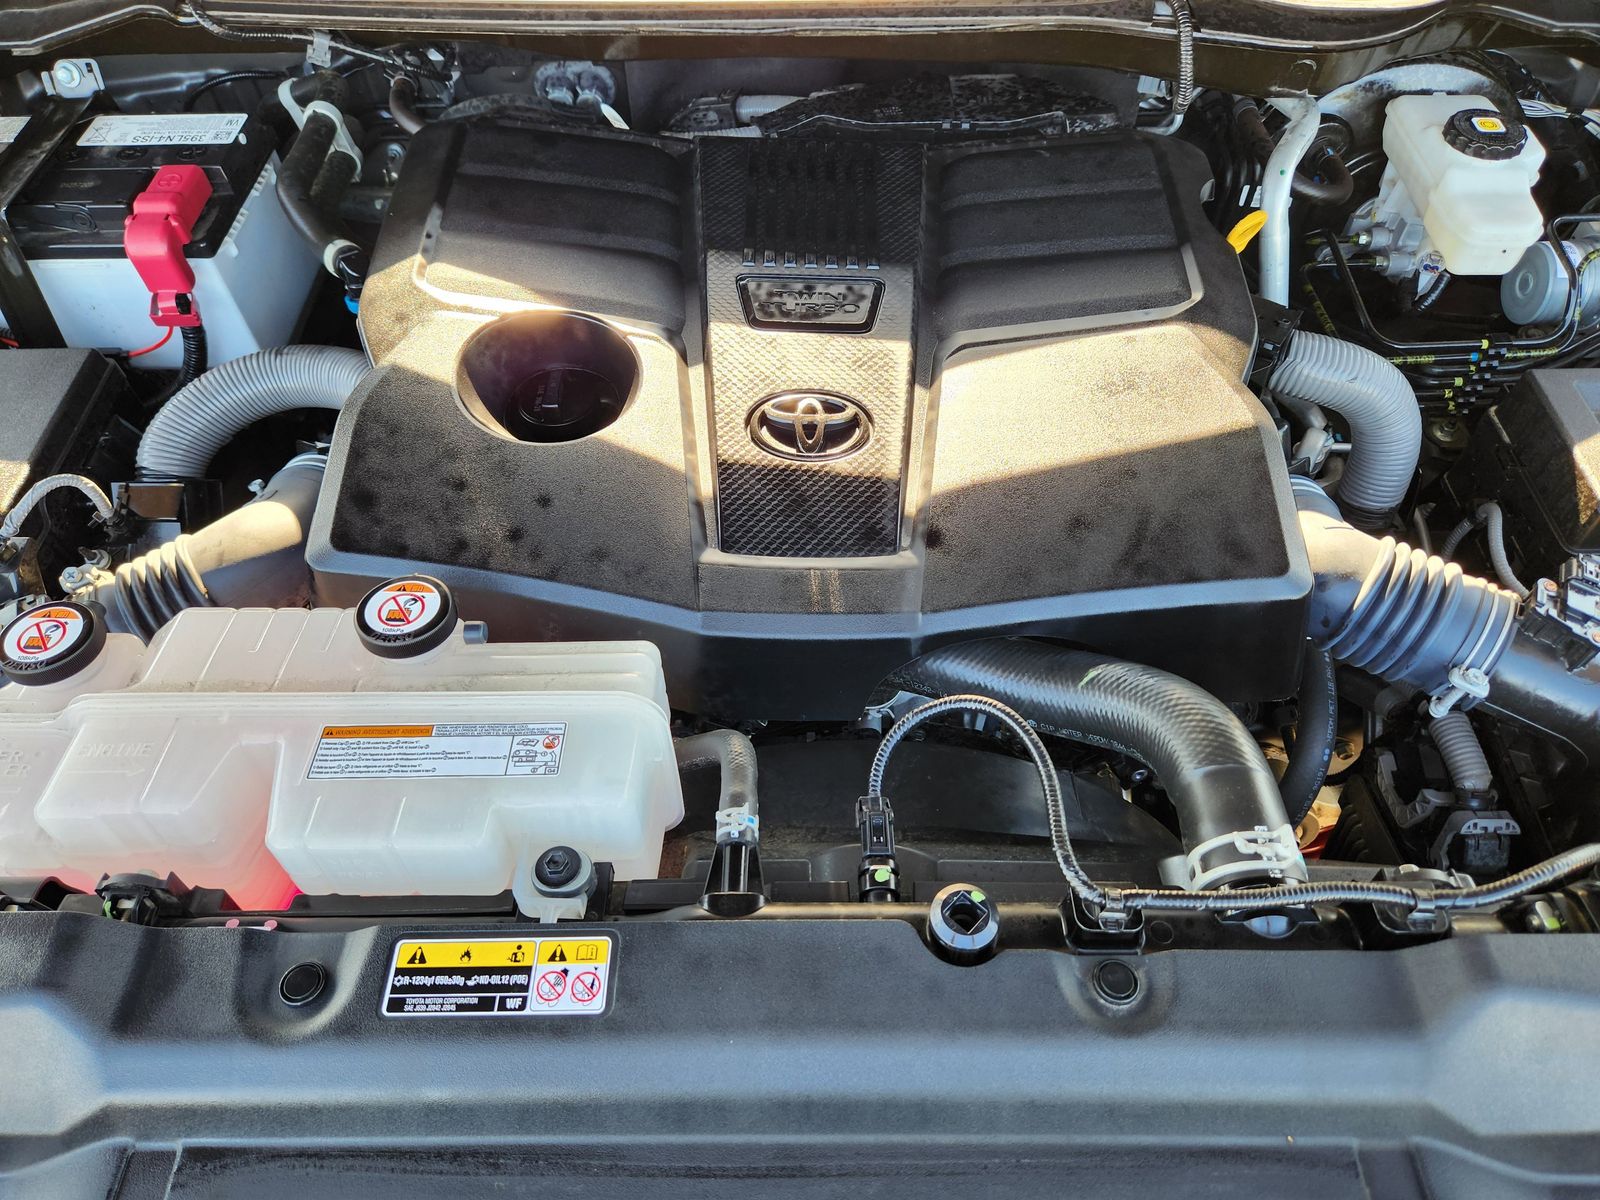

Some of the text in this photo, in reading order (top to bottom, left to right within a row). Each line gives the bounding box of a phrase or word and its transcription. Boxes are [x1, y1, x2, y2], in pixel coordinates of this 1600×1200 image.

[773, 288, 844, 301] TWIN
[758, 301, 860, 314] TURBO
[3, 659, 47, 671] DENSO
[78, 742, 154, 758] ENGINE
[505, 997, 523, 1010] WF
